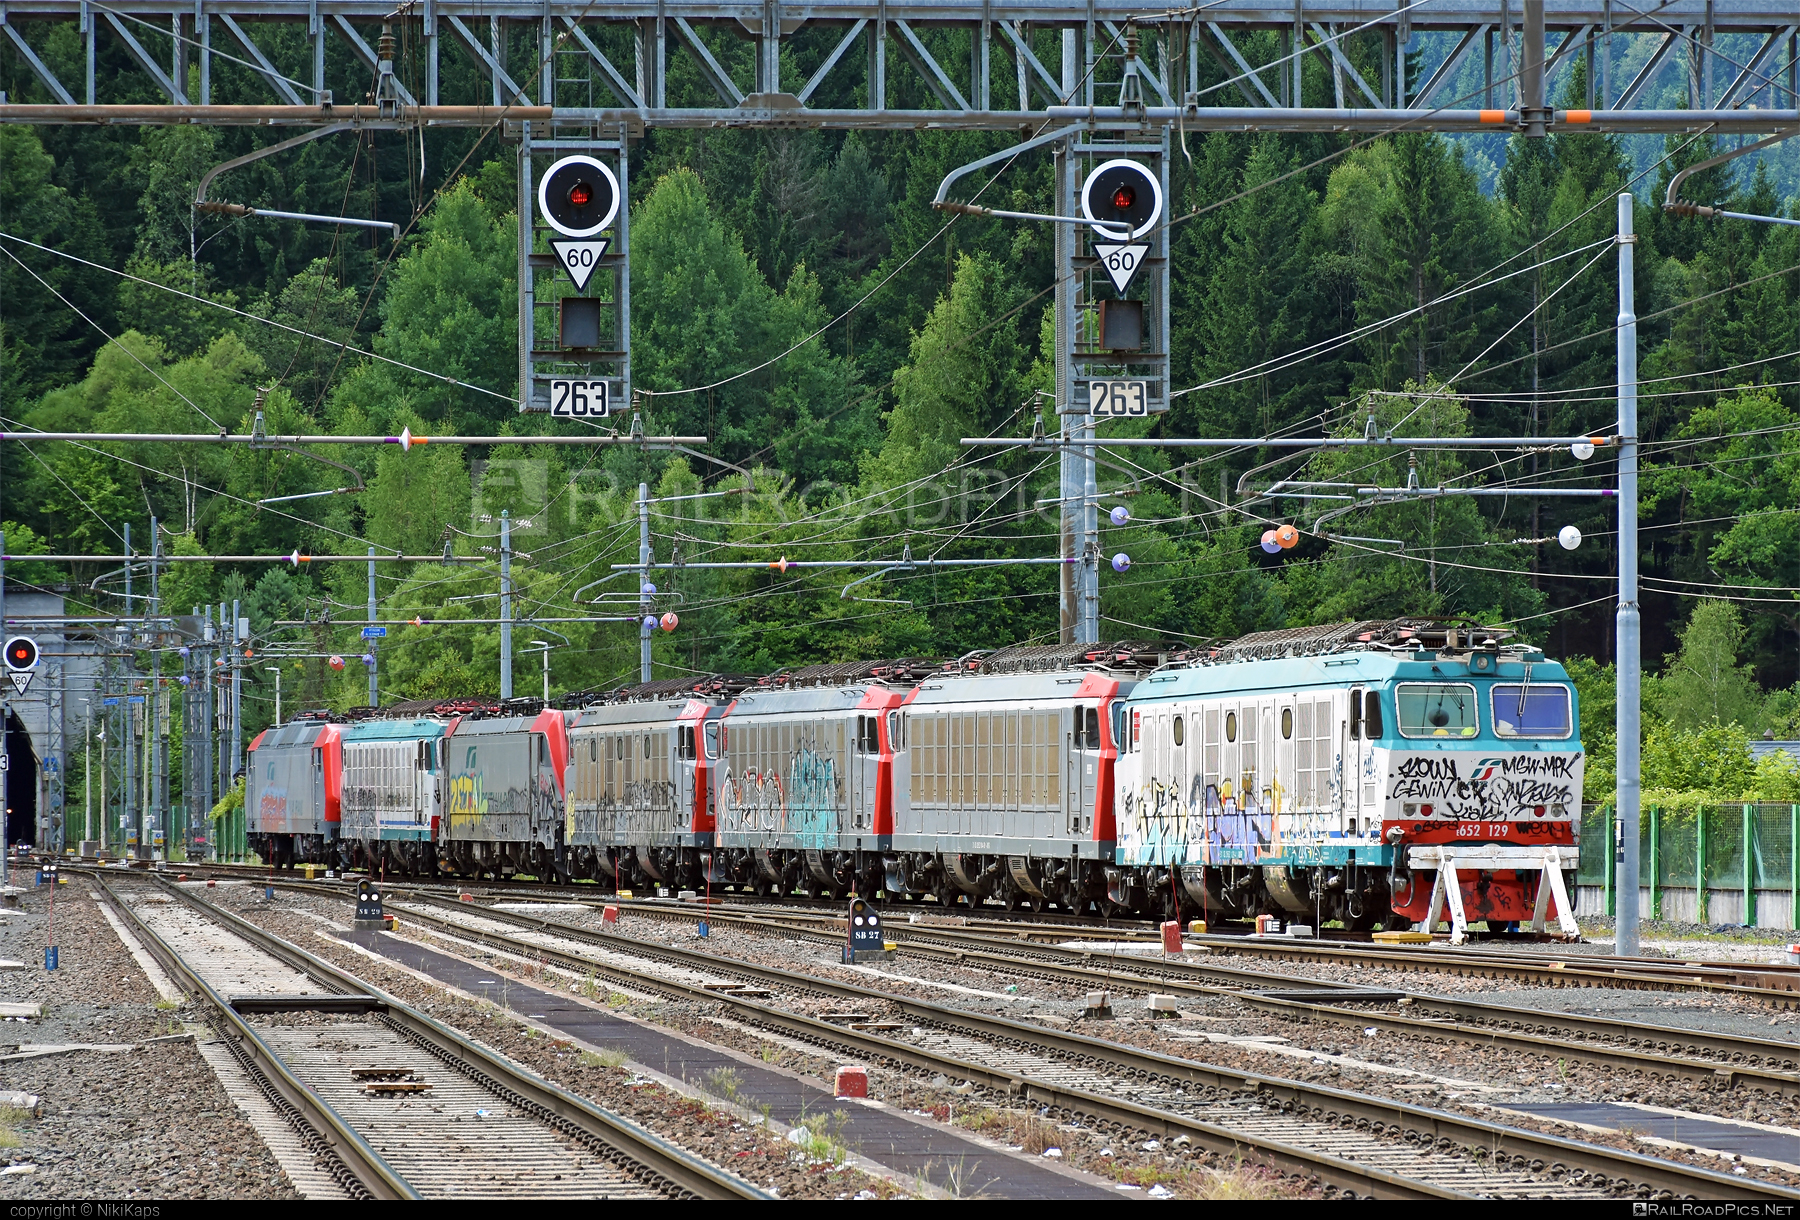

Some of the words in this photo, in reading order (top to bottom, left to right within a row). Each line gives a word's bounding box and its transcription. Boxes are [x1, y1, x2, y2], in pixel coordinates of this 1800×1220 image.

[566, 248, 593, 268] 60
[1108, 251, 1135, 271] 60
[553, 381, 607, 416] 263
[1091, 381, 1146, 416] 263
[15, 676, 27, 686] 60
[1488, 824, 1509, 837] 129
[855, 931, 867, 940] SB
[868, 931, 880, 940] 27
